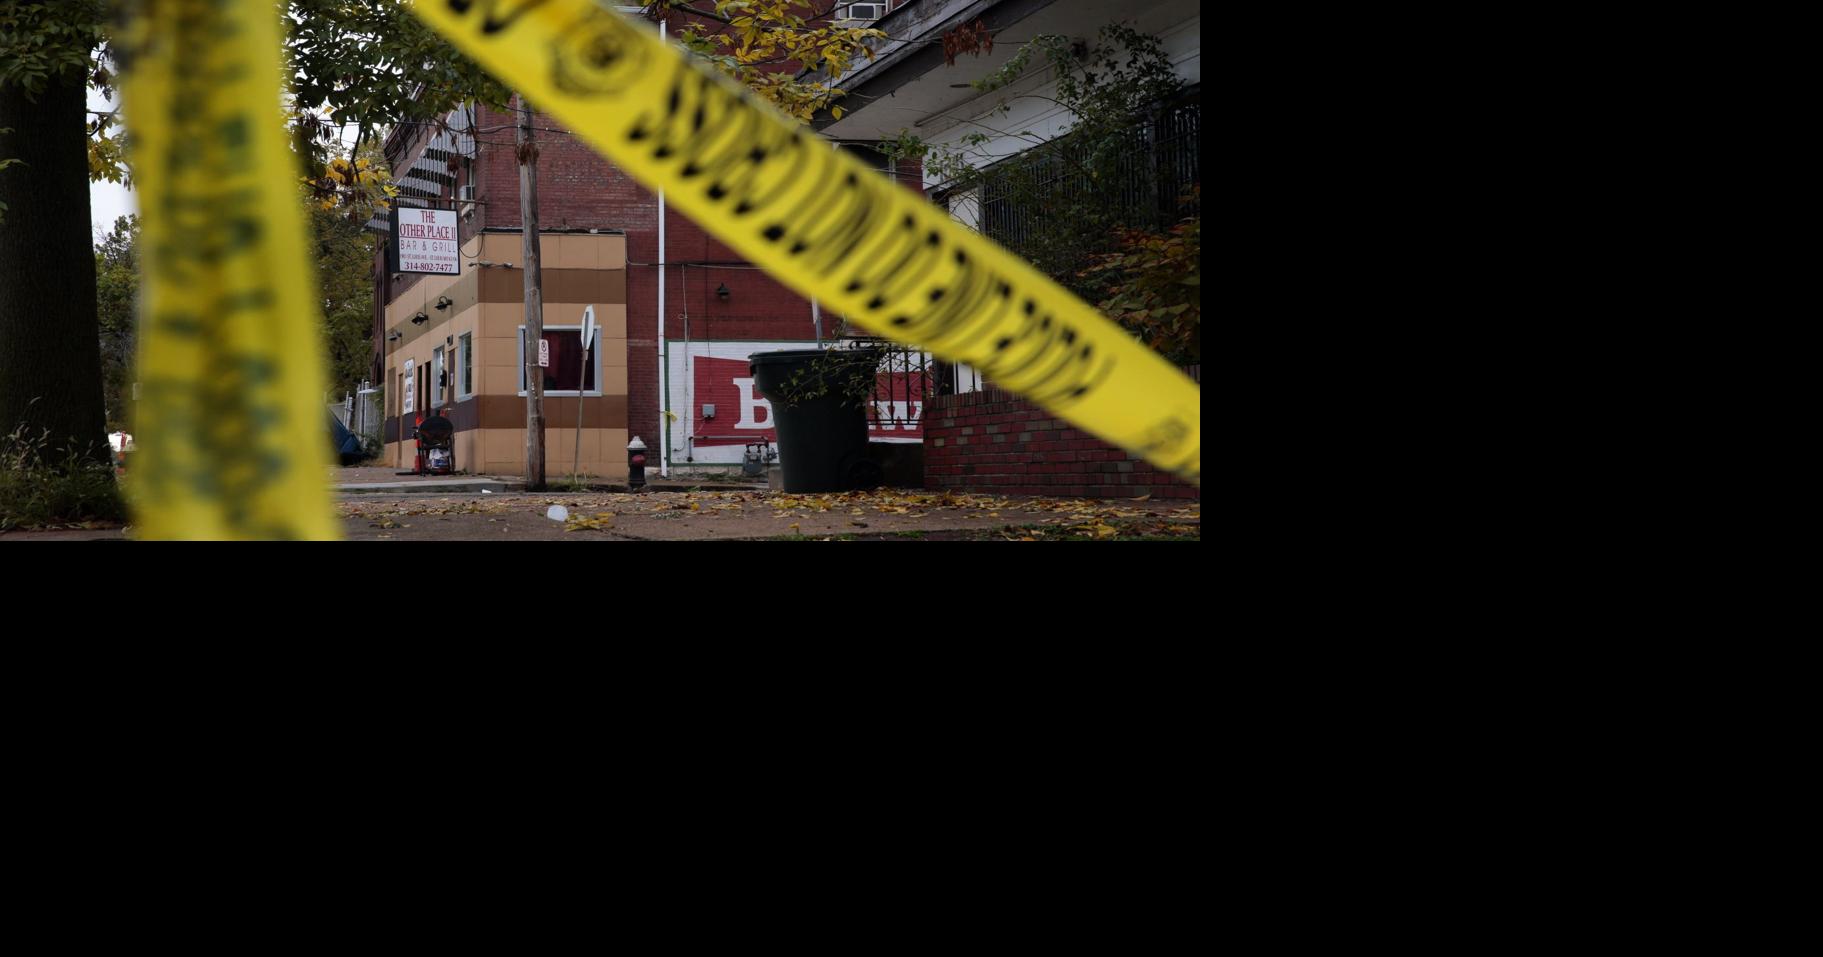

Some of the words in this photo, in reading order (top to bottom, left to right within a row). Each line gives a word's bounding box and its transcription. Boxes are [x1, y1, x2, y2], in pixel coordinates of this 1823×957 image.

[620, 58, 813, 224] CROSS
[420, 211, 435, 223] THE
[400, 224, 425, 237] OTHER
[427, 225, 449, 239] PLACE
[451, 226, 456, 240] II
[758, 164, 905, 292] NOT
[400, 240, 416, 250] BAR
[422, 241, 426, 251] &
[432, 242, 456, 252] GRILL
[404, 262, 453, 272] 314-802-7477
[887, 243, 1016, 358] LINE
